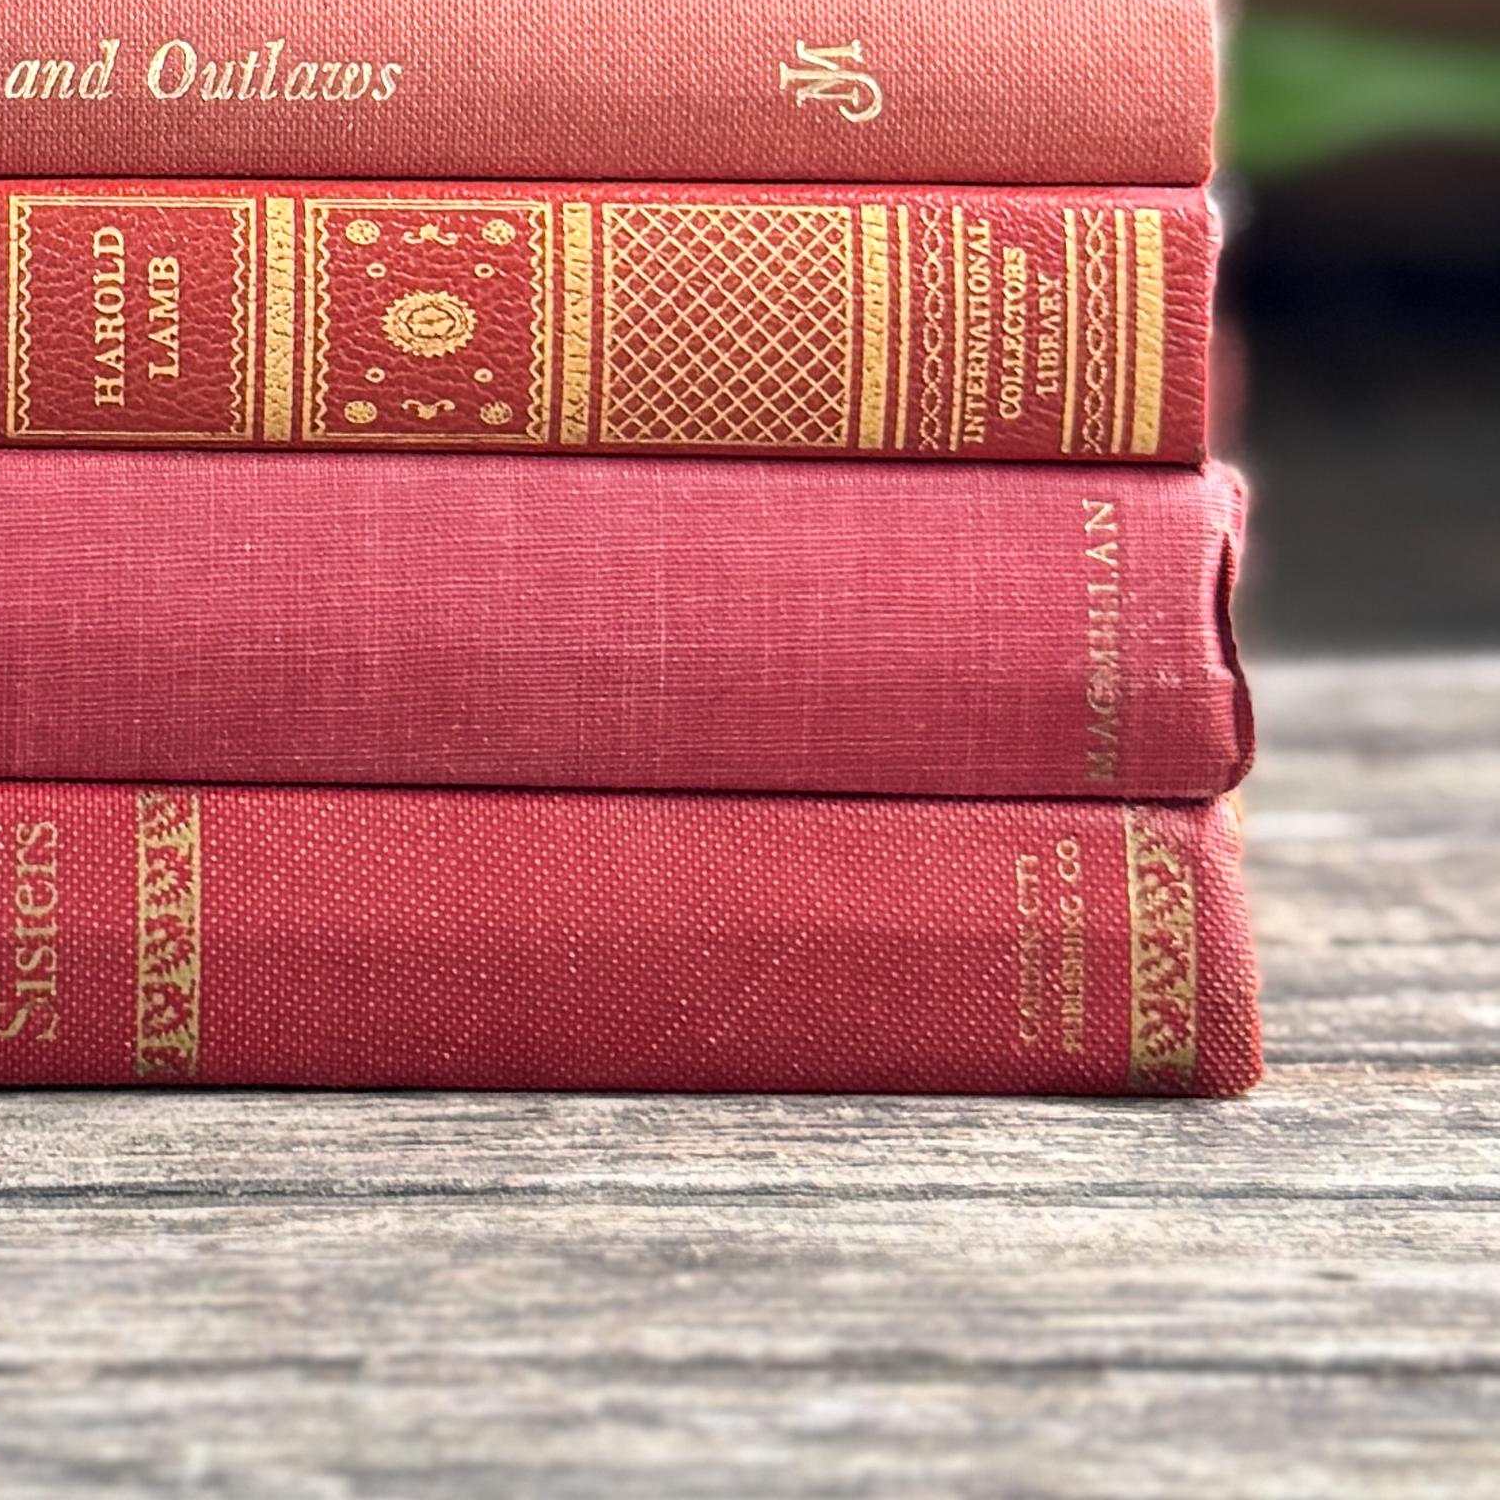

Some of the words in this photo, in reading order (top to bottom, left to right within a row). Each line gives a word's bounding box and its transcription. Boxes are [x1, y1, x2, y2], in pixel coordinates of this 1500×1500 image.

[5, 38, 121, 101] and
[147, 39, 401, 102] Outlaws
[93, 226, 125, 406] HAROLD
[149, 256, 180, 378] LAMB
[963, 219, 991, 444] INTERNATIONAL
[999, 246, 1027, 419] COLLECTORS
[1036, 273, 1061, 398] LIBRARY
[1082, 498, 1120, 781] MACMILLAN
[1059, 894, 1084, 1054] PUBLISHING
